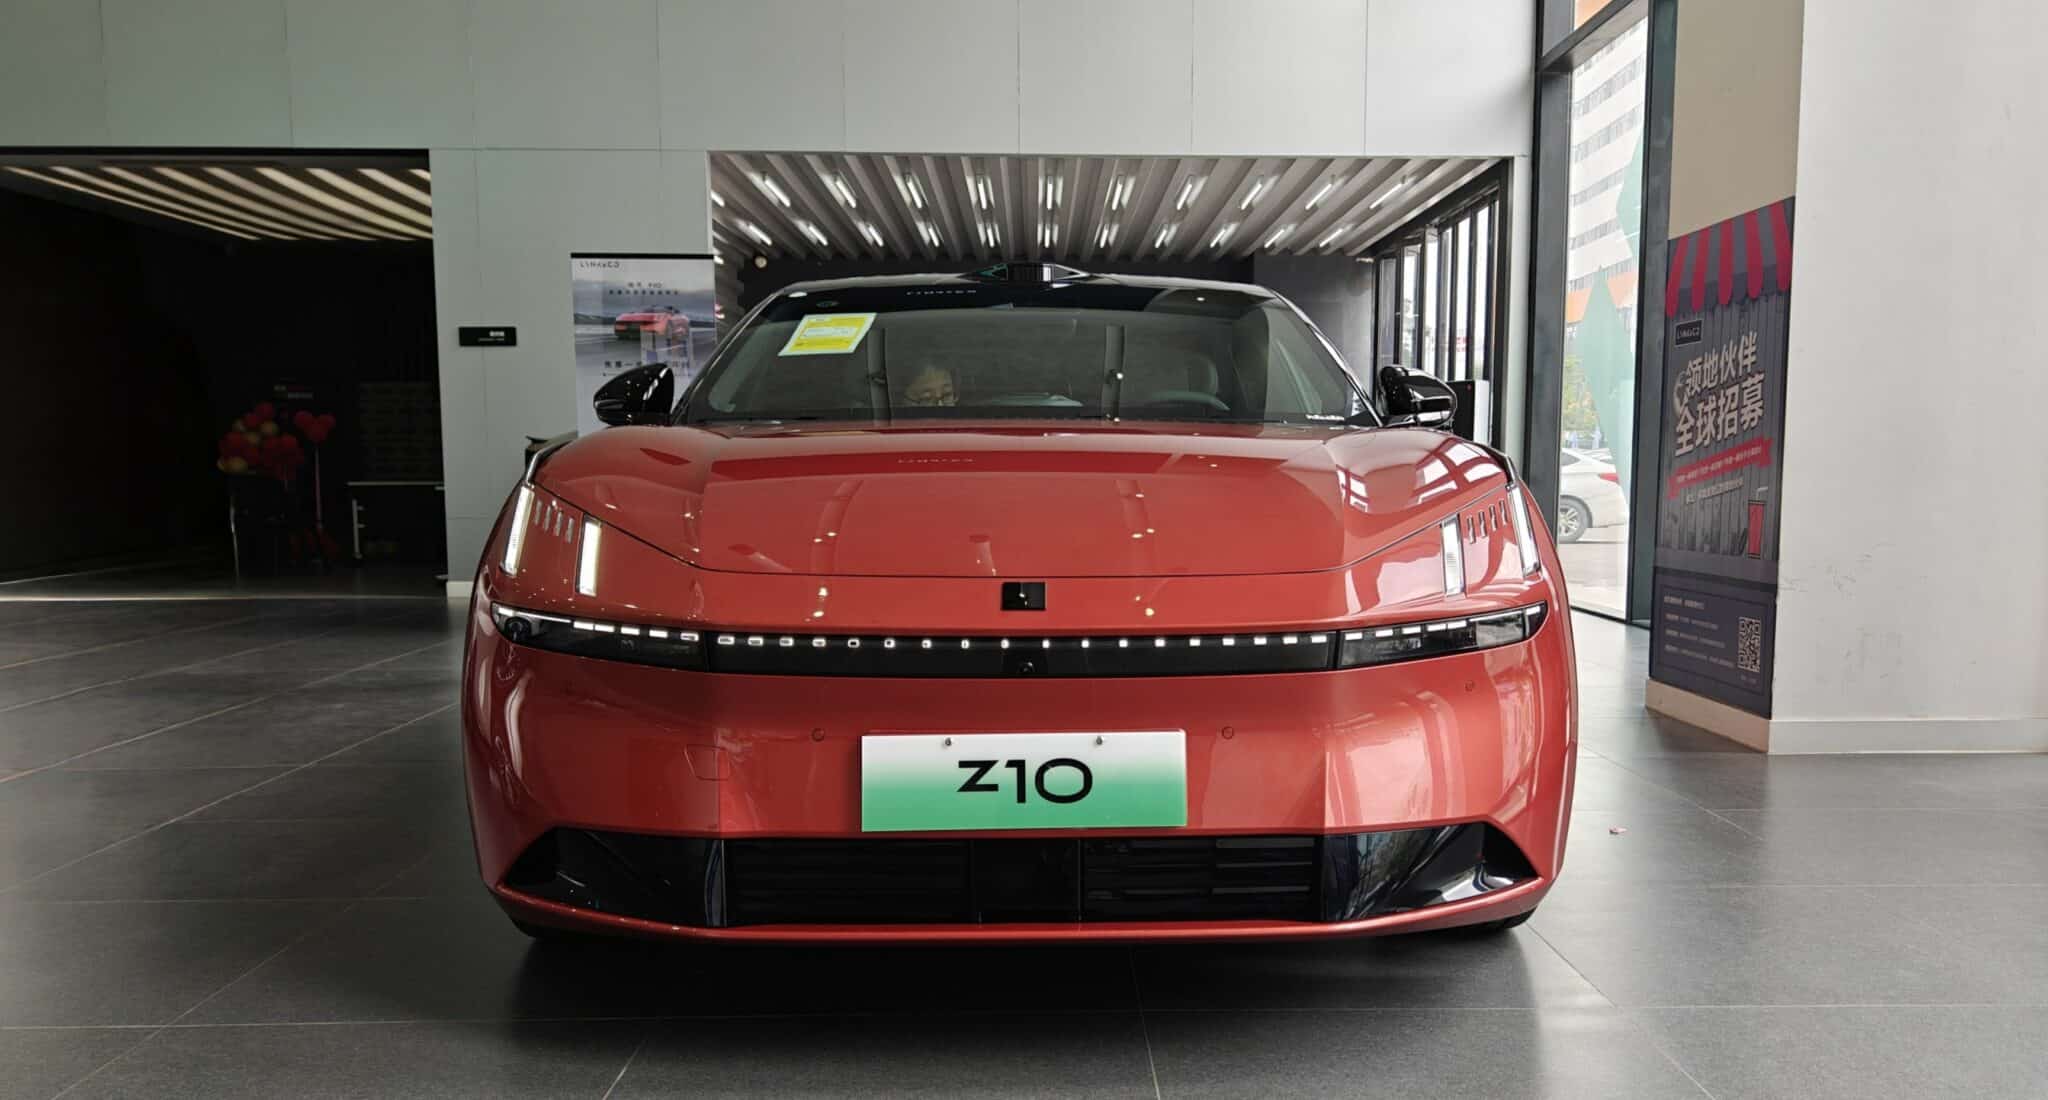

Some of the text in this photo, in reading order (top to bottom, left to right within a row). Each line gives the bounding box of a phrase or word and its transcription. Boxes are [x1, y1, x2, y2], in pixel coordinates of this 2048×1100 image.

[1685, 331, 1758, 397] 领地伙伴
[1674, 372, 1765, 457] 全球招募
[956, 757, 1093, 804] Z10
